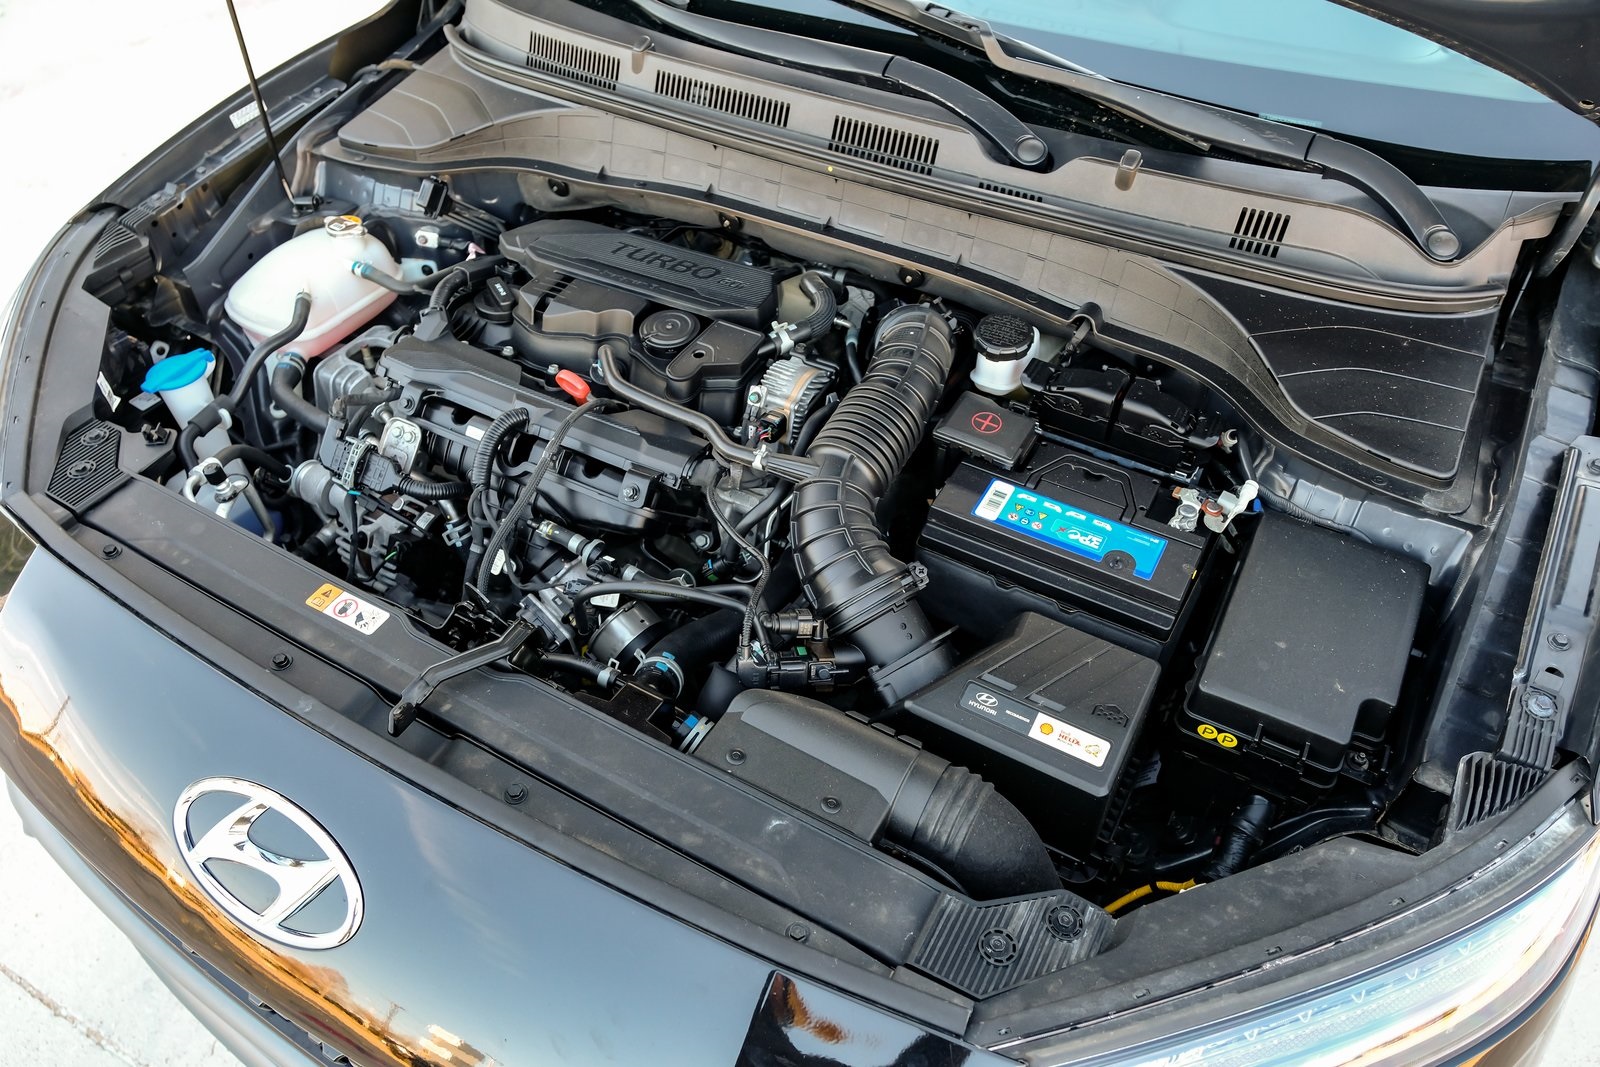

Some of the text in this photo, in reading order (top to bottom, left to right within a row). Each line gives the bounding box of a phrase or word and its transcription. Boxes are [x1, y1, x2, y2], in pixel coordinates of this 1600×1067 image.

[610, 241, 721, 279] TURBO
[968, 700, 997, 716] HYUNDAI
[1058, 733, 1080, 746] HELIX
[1202, 727, 1234, 743] P P
